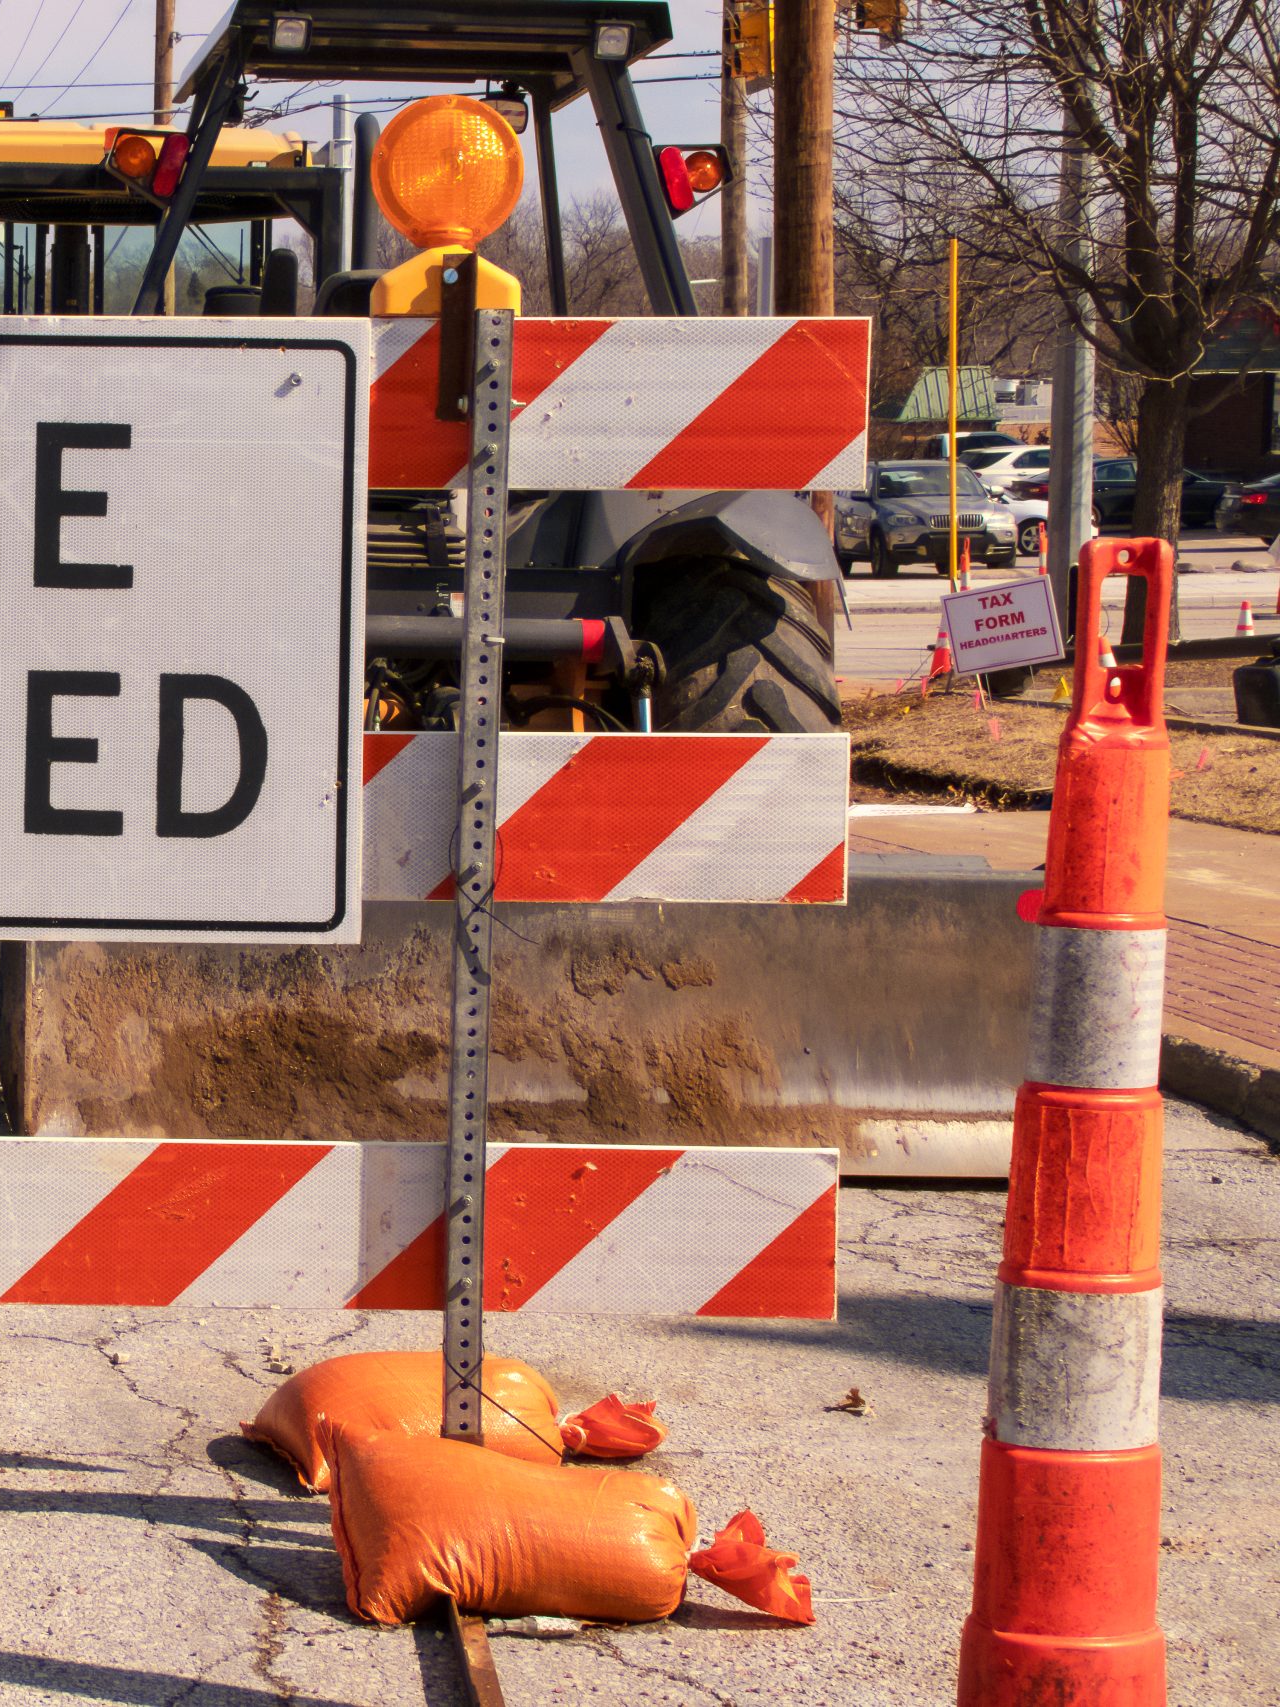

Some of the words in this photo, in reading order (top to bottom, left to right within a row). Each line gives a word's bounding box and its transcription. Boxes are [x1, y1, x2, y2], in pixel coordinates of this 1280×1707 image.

[978, 592, 1014, 610] TAX
[974, 611, 1025, 632] FORM
[960, 627, 1048, 650] HEADQUARTERS
